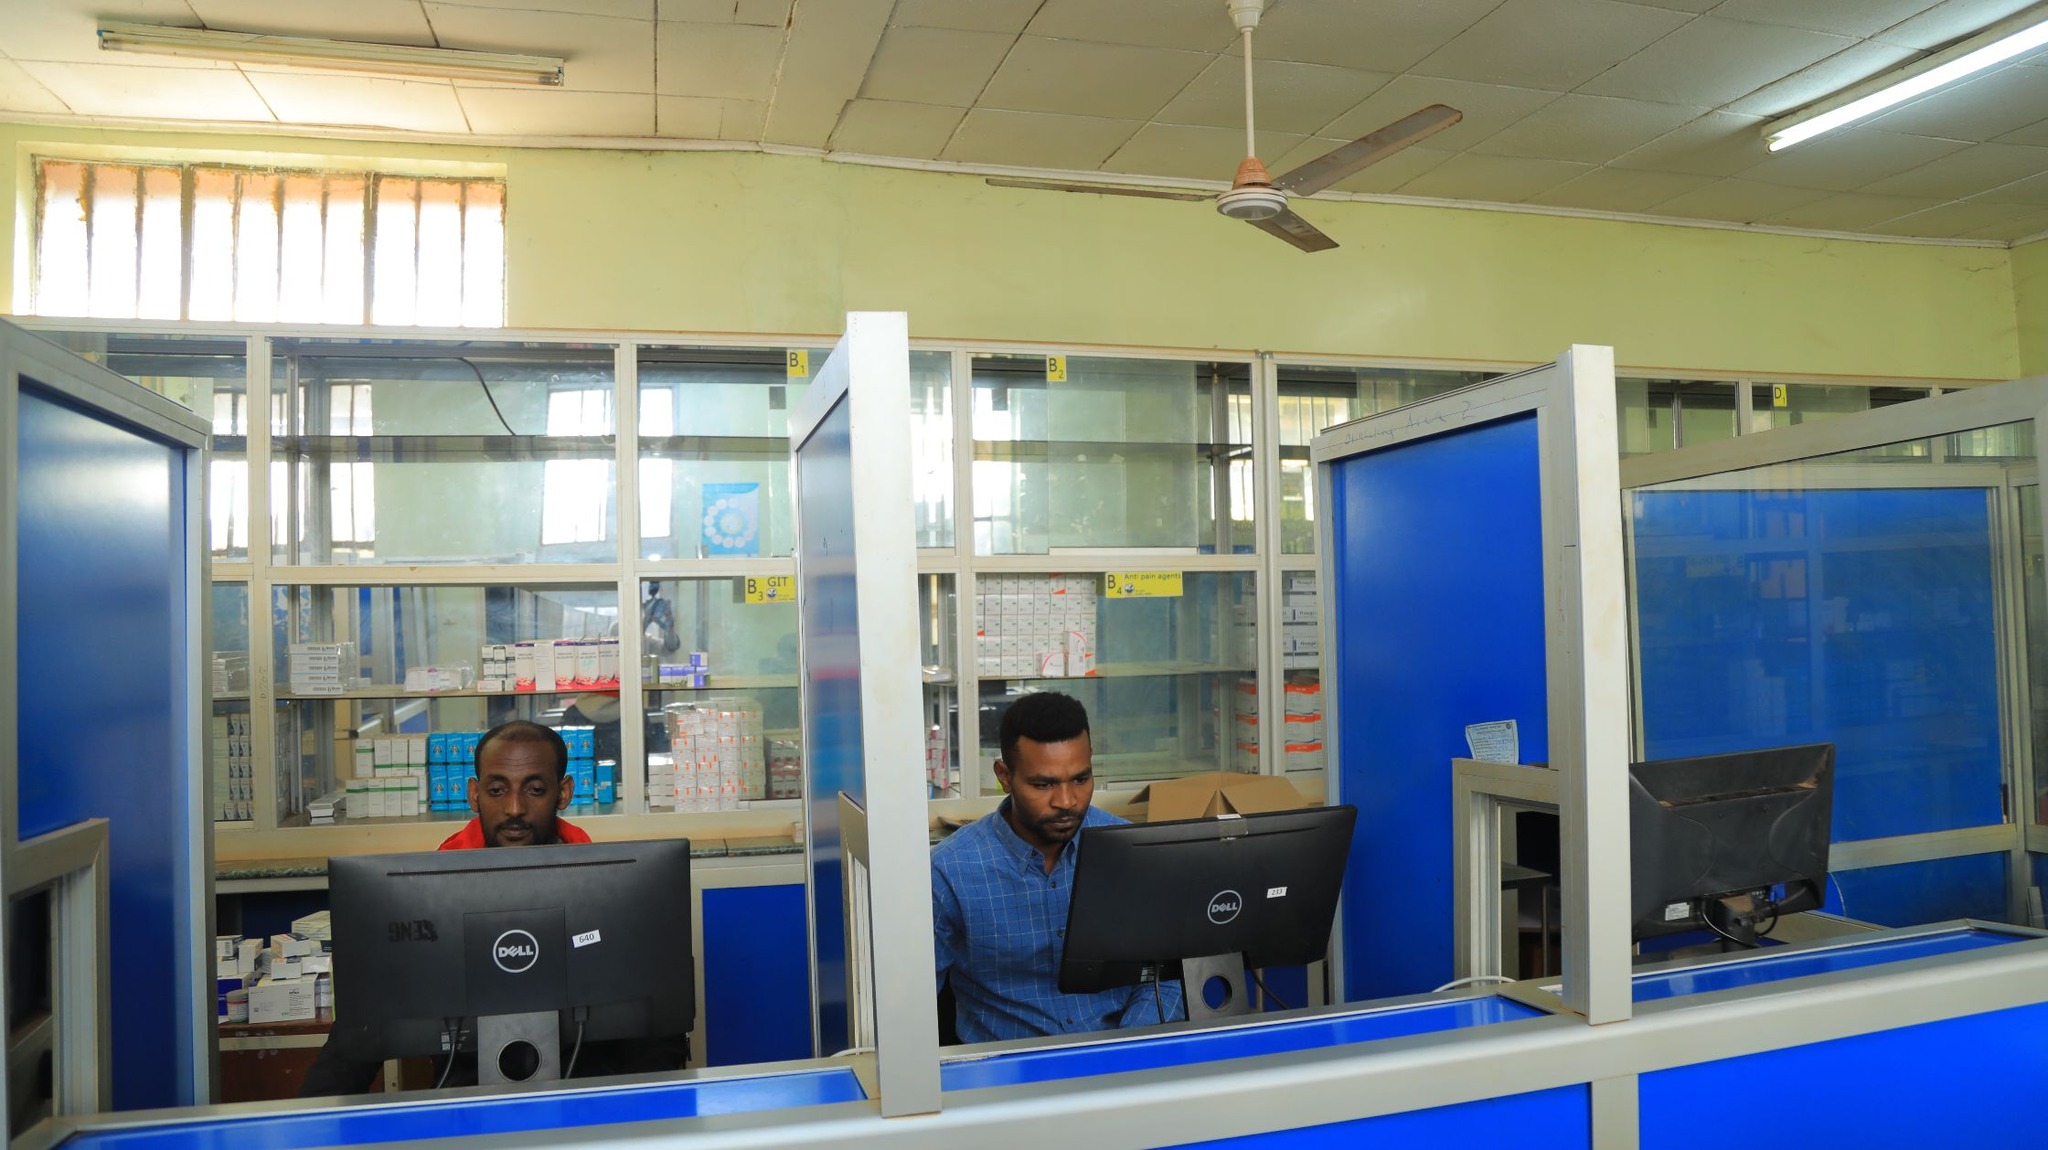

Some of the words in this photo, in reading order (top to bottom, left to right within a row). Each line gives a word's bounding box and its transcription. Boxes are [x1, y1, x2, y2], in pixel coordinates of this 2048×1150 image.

[790, 352, 799, 367] B
[1049, 358, 1058, 372] B
[1775, 387, 1782, 399] D
[767, 576, 789, 587] GIT
[1107, 574, 1116, 589] B
[1140, 573, 1156, 581] pain
[748, 579, 757, 594] B
[1211, 902, 1238, 913] DELL
[579, 933, 596, 944] 640
[498, 944, 534, 957] DELL
